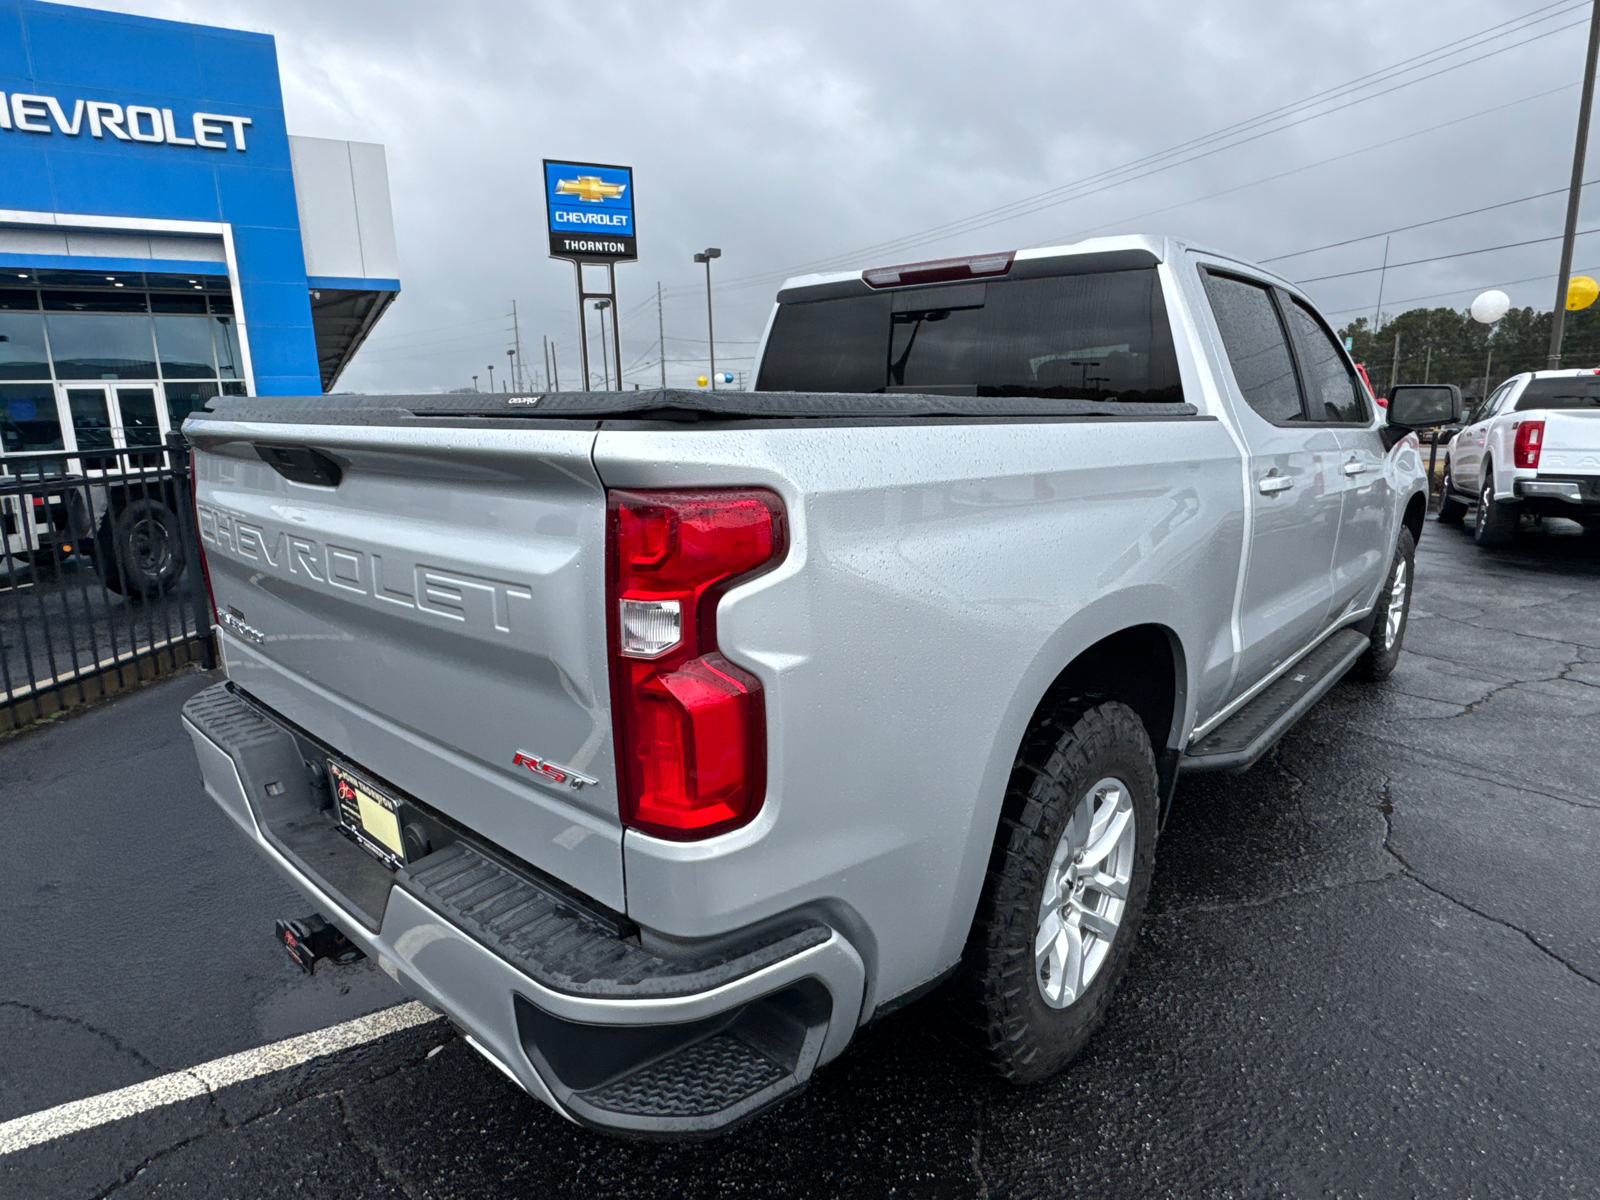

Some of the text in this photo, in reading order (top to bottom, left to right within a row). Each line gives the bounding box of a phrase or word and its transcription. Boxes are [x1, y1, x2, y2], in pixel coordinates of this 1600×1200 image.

[0, 91, 252, 150] EVROLET
[555, 211, 628, 226] CHEVROLET
[564, 239, 625, 252] THORNTON
[198, 504, 532, 632] CHEVROLET
[513, 749, 599, 790] RST
